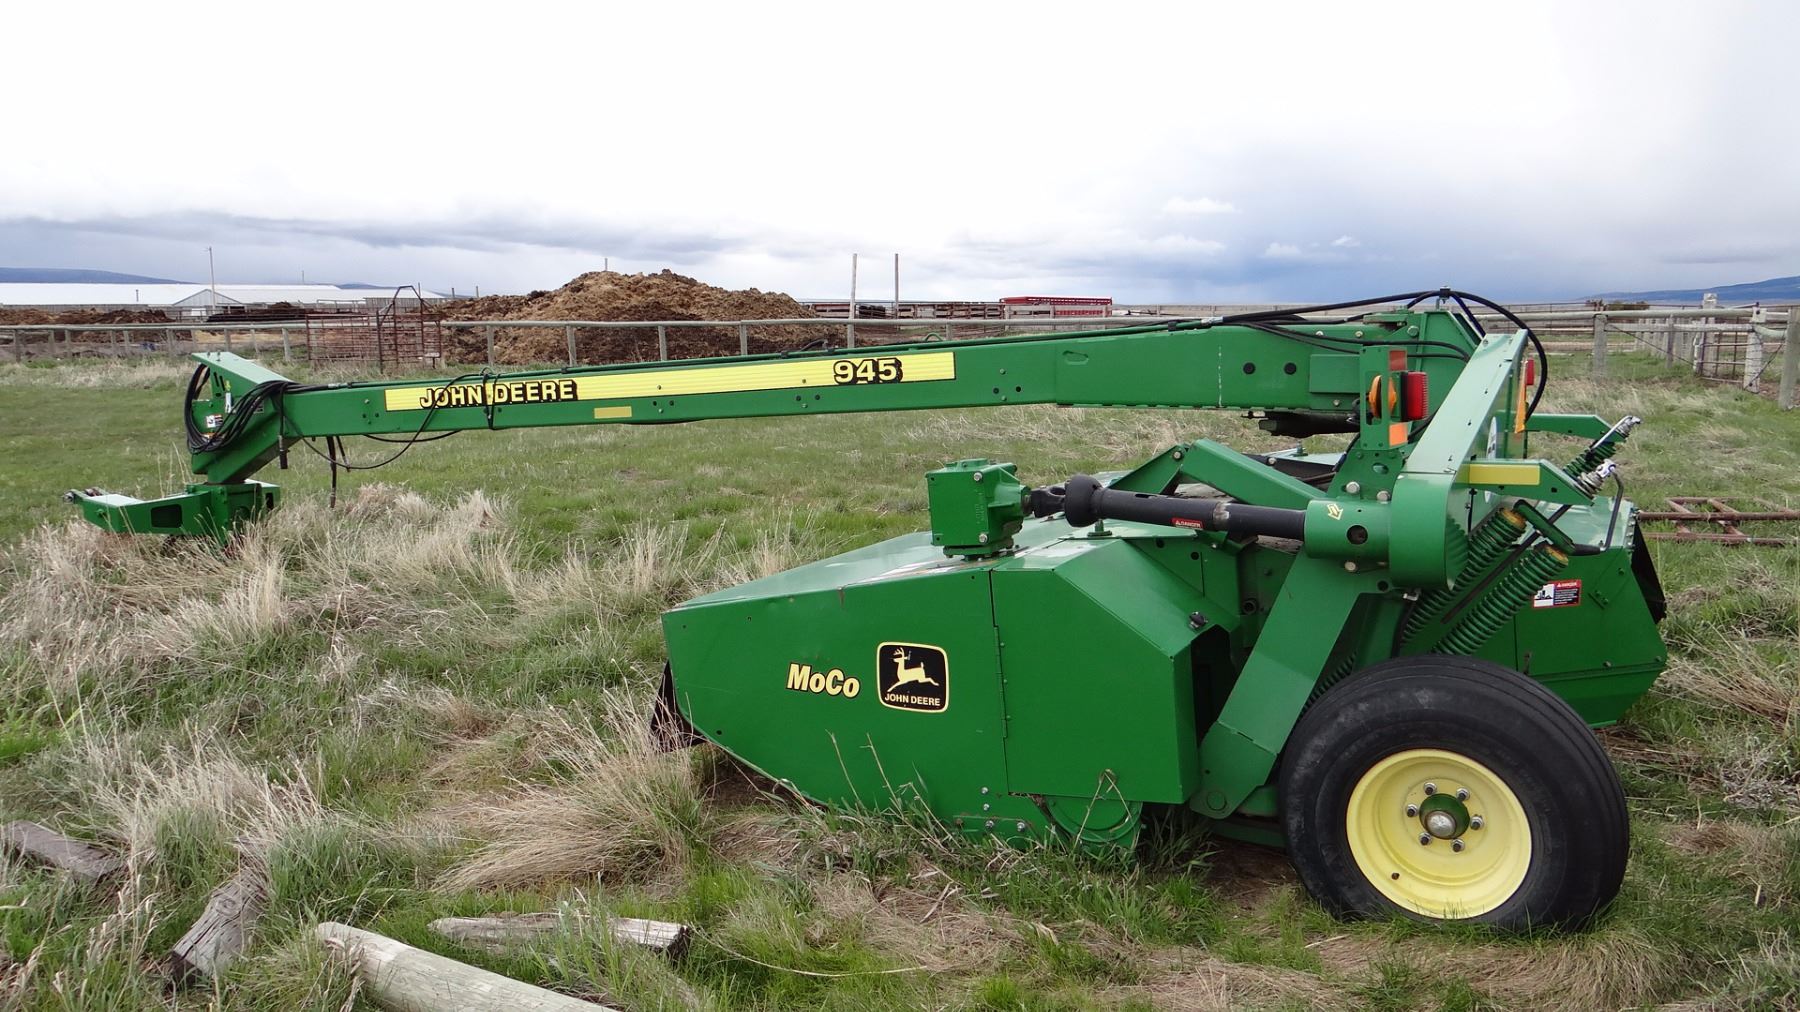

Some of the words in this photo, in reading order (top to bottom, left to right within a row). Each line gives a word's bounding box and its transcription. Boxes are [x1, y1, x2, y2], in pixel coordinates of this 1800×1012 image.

[833, 358, 902, 384] 945
[420, 384, 484, 408] JOHN
[494, 379, 577, 404] DEERE
[786, 662, 861, 699] MoCo
[884, 693, 909, 703] JOHN
[910, 695, 941, 706] DEERE
